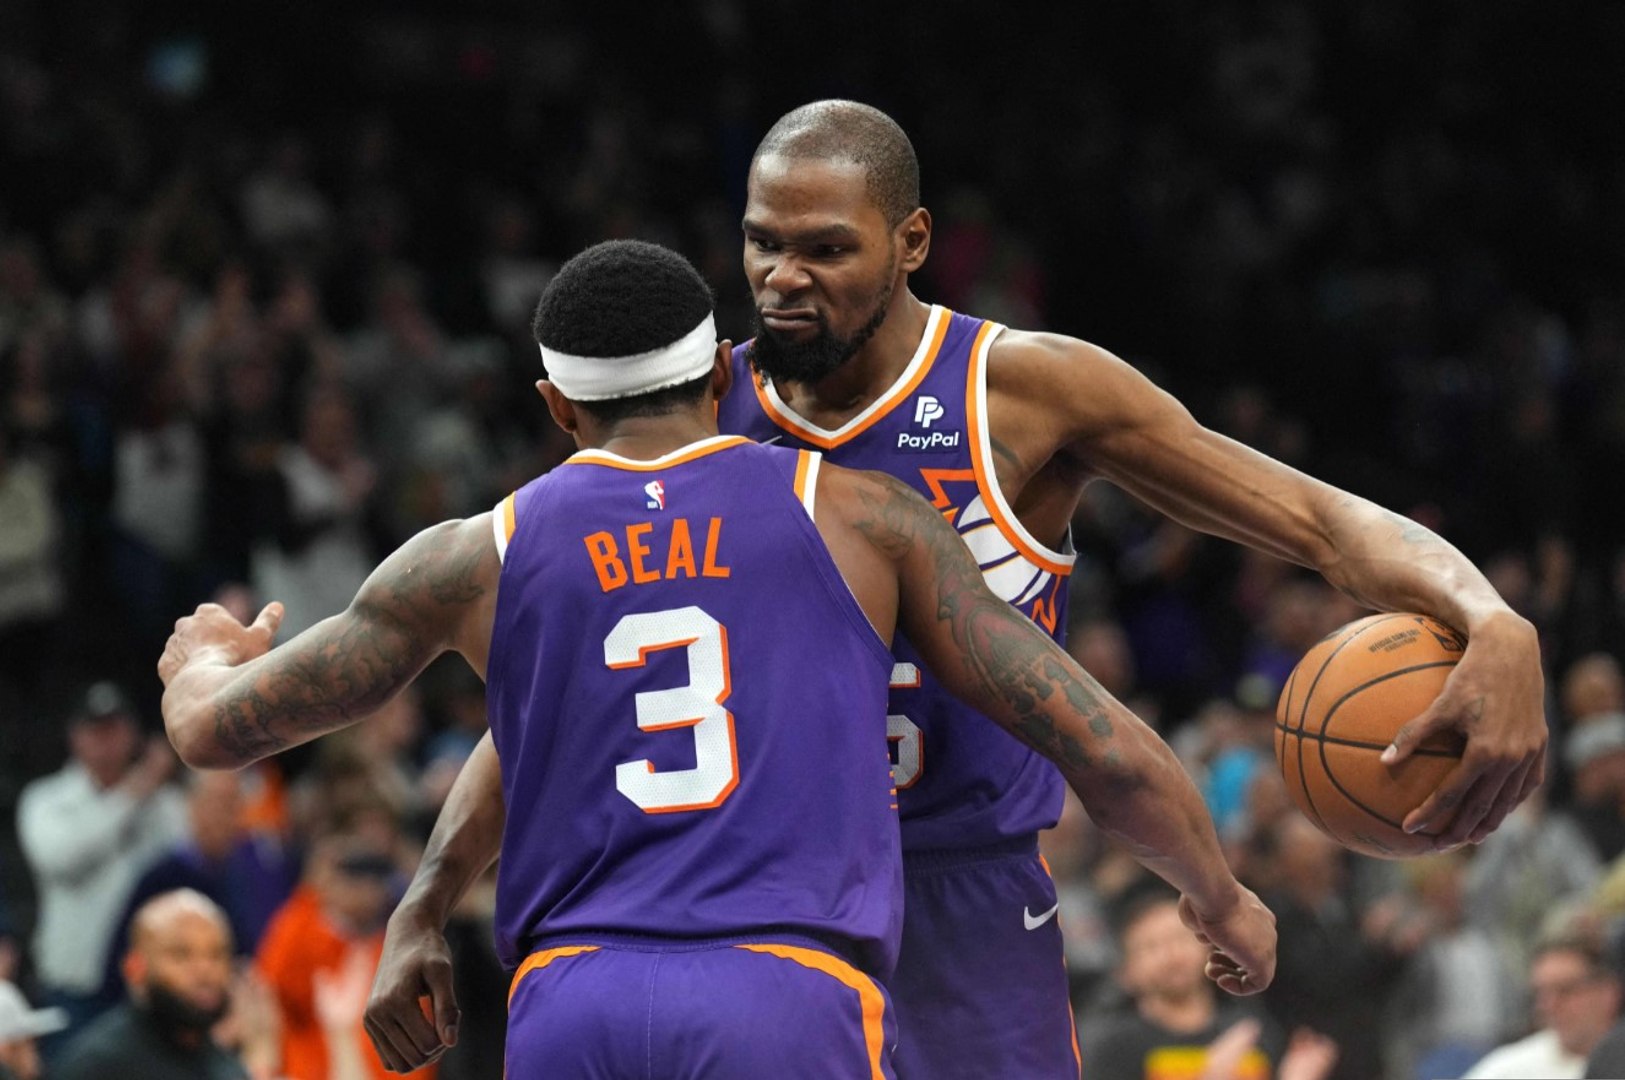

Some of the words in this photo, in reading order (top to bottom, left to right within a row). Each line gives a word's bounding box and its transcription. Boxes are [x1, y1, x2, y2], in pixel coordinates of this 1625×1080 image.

[897, 431, 960, 450] PayPal
[583, 516, 731, 593] BEAL
[603, 605, 740, 815] 3
